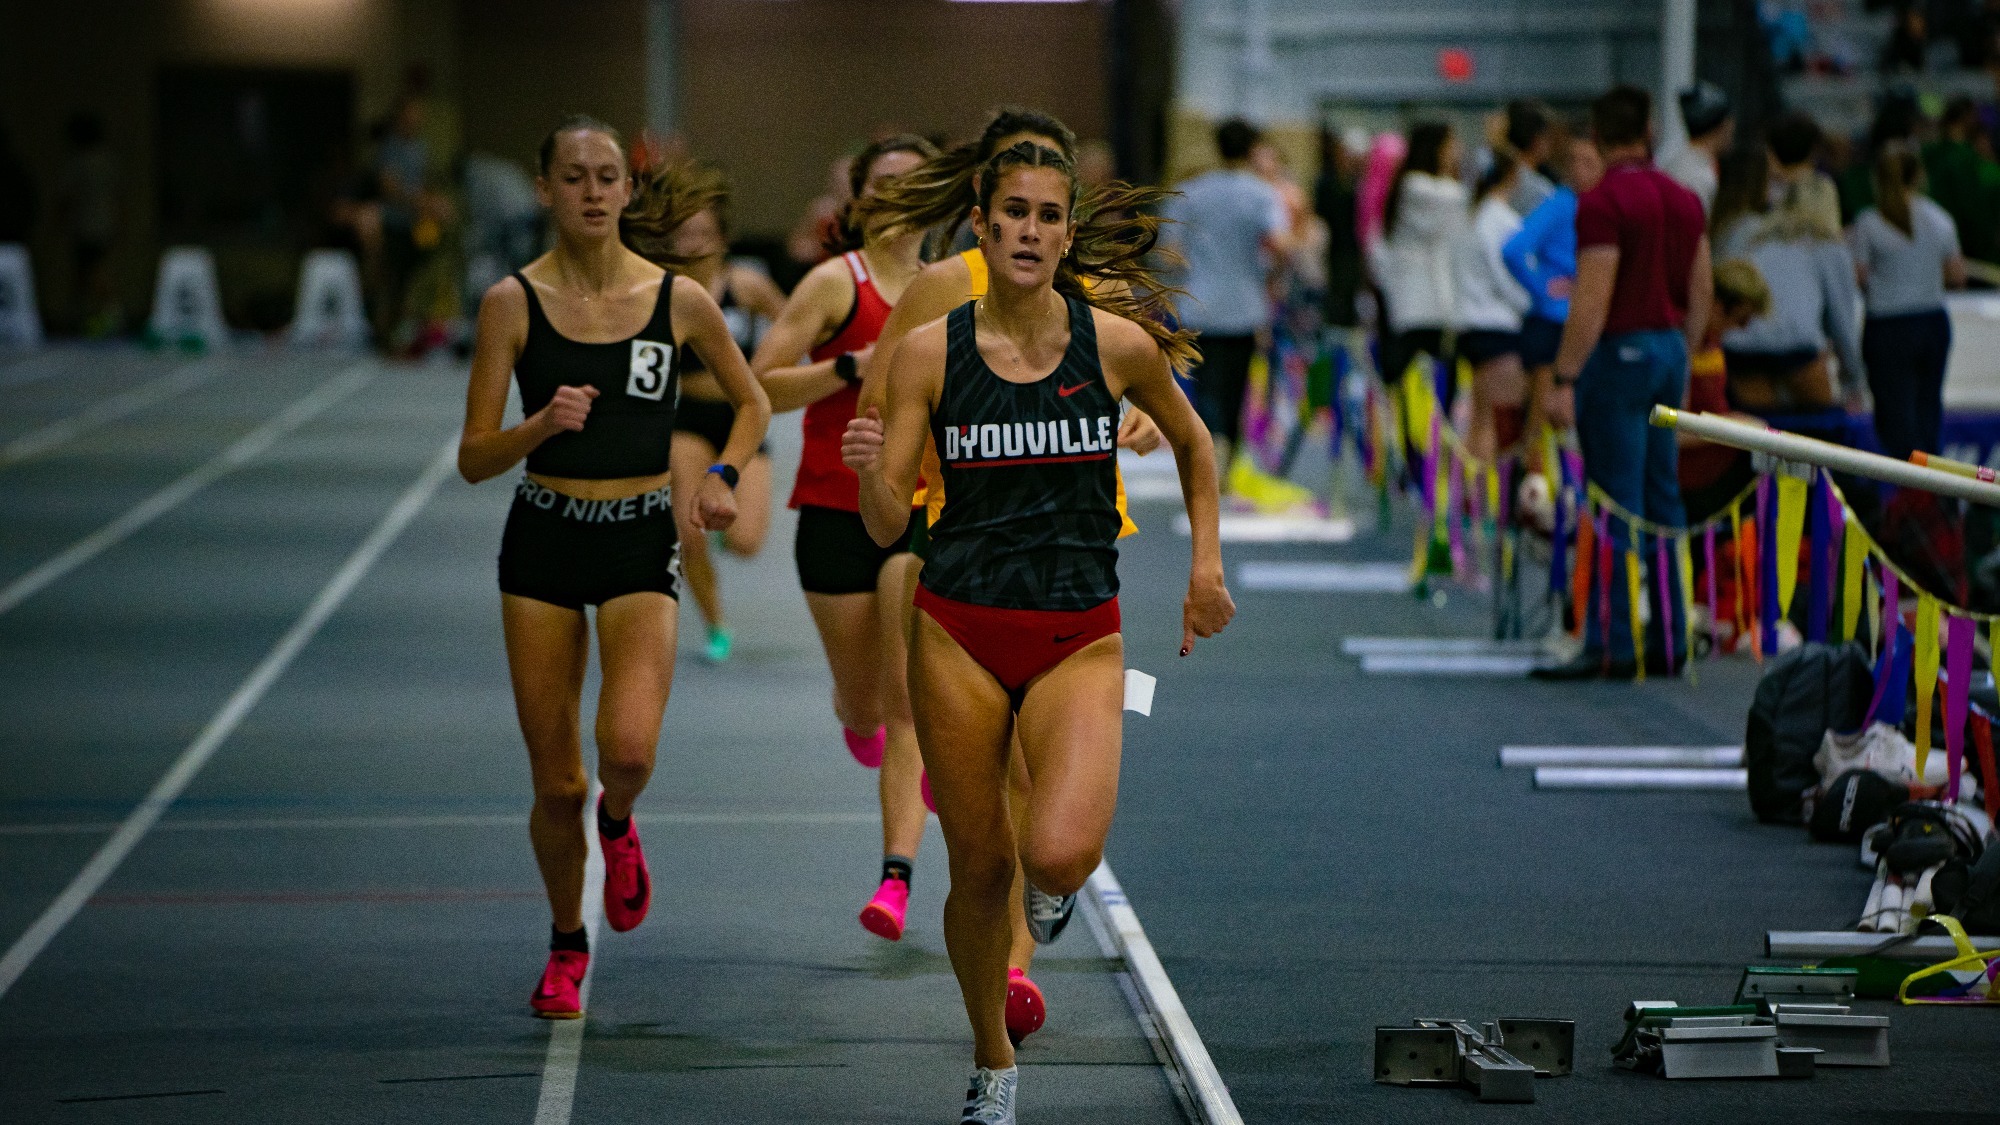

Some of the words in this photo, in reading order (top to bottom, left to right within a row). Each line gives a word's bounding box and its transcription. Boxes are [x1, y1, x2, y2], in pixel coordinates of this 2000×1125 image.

[636, 346, 665, 394] 3
[944, 416, 1112, 460] D'YOUVILLE
[562, 496, 638, 523] NIKE
